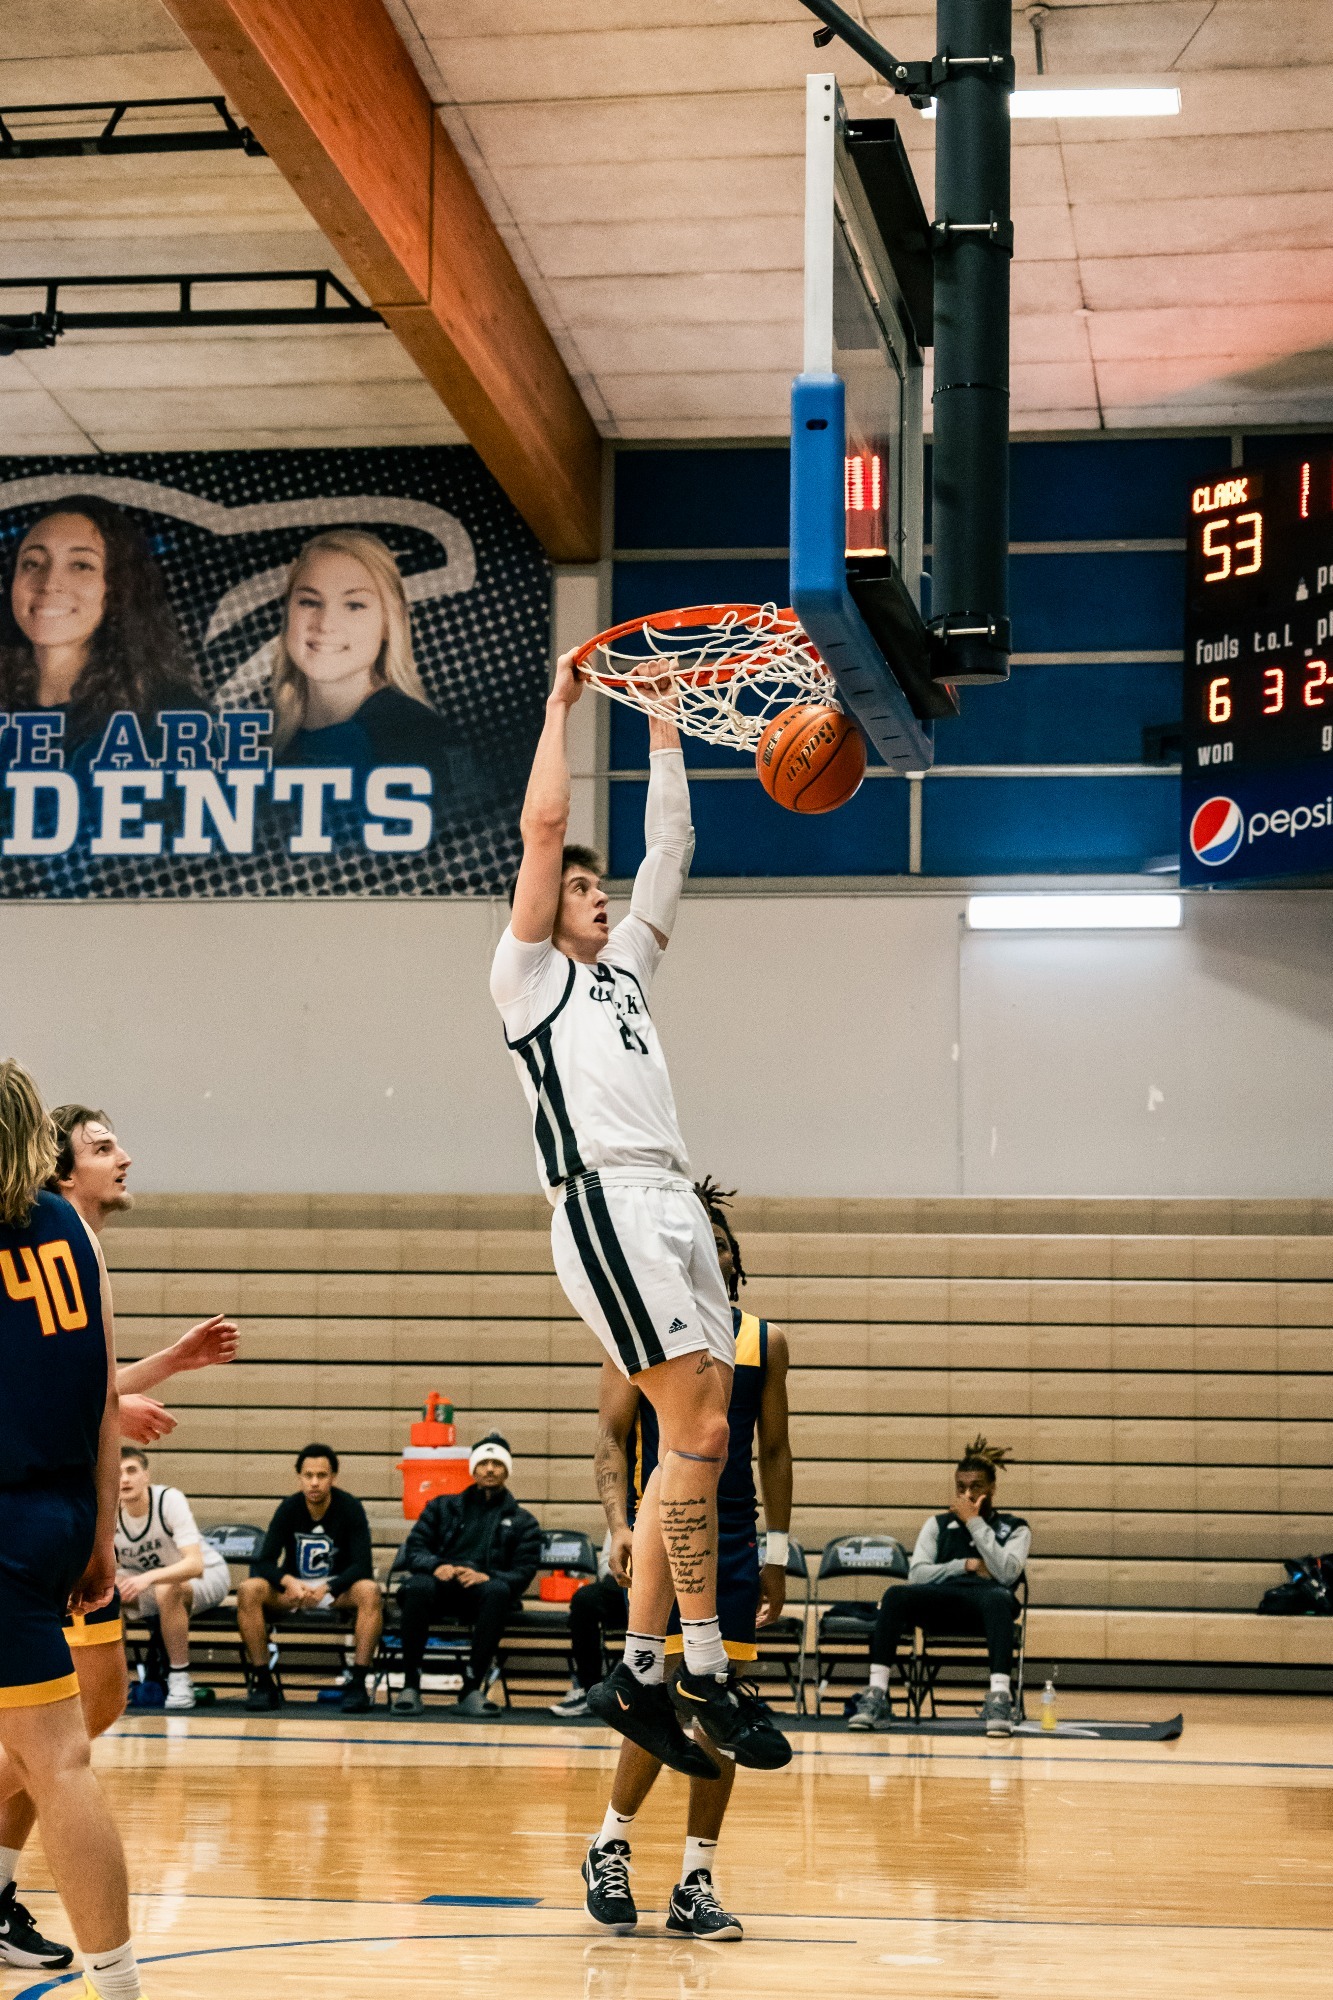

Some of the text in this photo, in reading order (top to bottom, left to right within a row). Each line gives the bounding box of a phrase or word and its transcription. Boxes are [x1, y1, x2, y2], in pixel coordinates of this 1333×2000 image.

[1192, 477, 1248, 514] CLARK
[1203, 511, 1263, 582] 53
[1196, 633, 1240, 665] fouls
[1208, 677, 1231, 723] 6
[1262, 668, 1284, 714] 3
[0, 710, 273, 773] E ARE
[785, 720, 838, 782] Baden
[1198, 742, 1234, 767] won
[3, 766, 434, 855] DENTS
[1248, 795, 1333, 844] pepsi
[0, 1239, 88, 1337] 40
